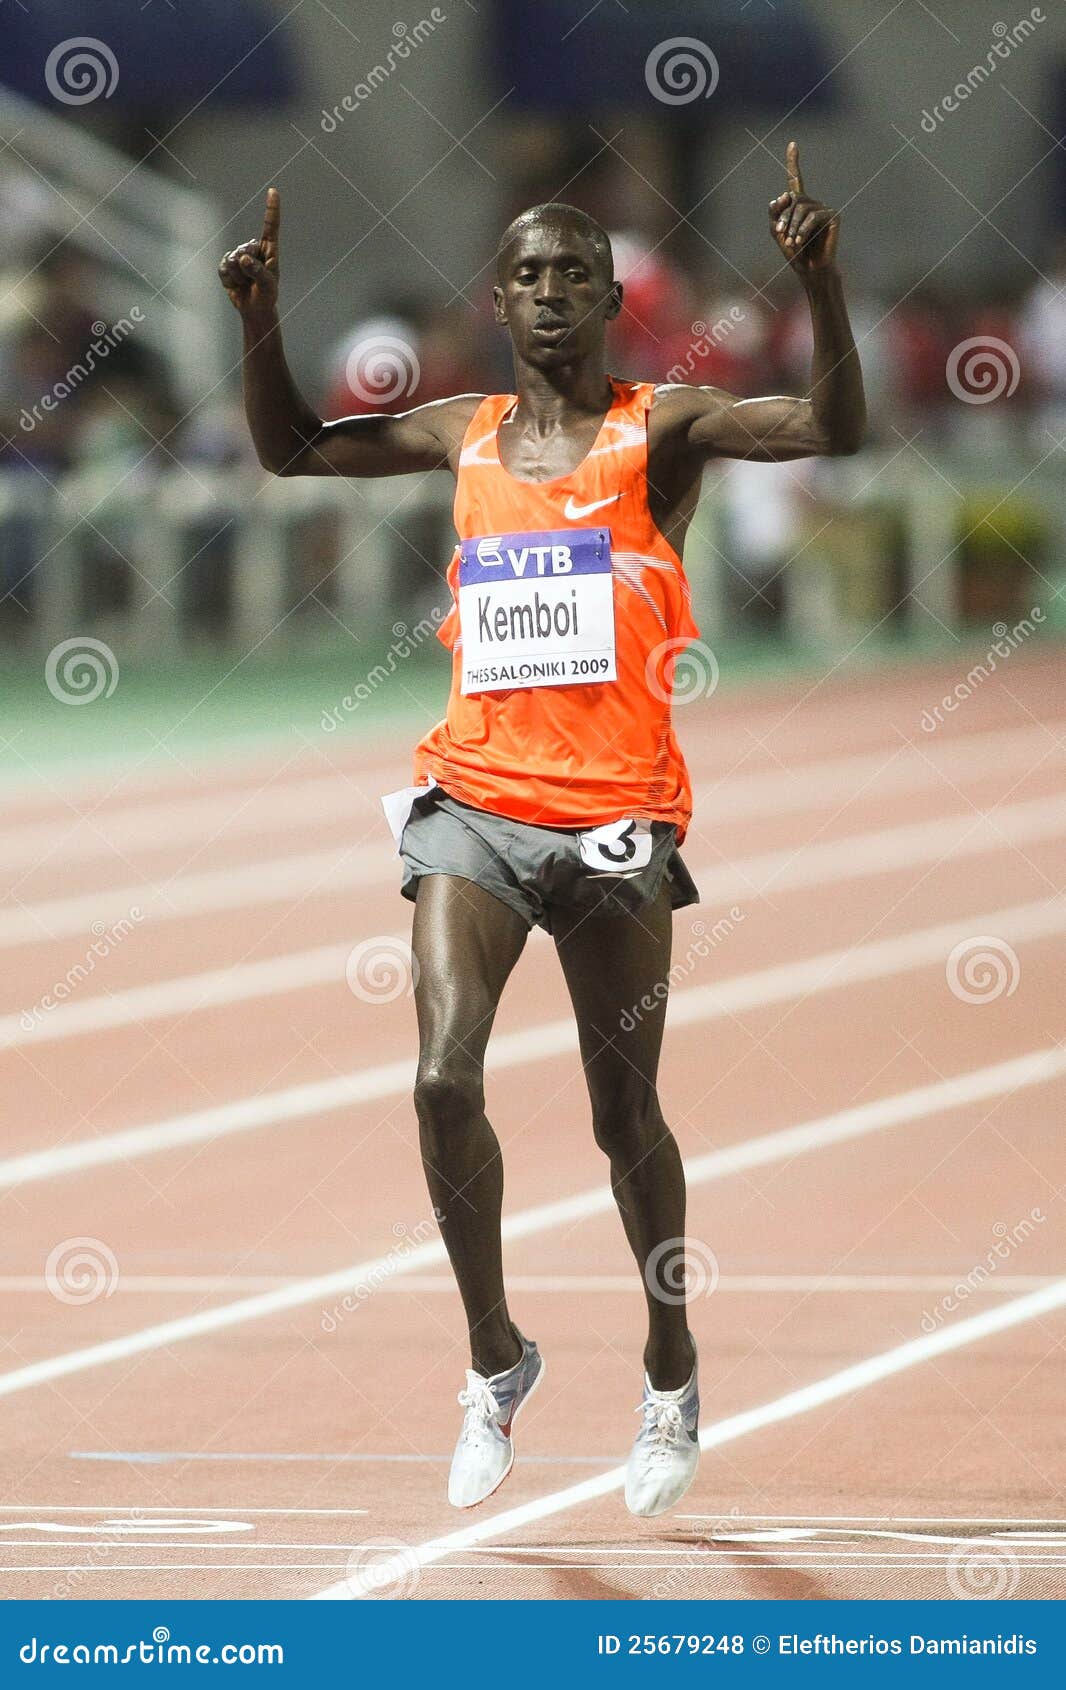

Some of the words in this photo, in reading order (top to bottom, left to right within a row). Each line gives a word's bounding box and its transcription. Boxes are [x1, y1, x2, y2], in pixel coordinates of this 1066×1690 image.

[507, 545, 573, 577] VTB
[478, 589, 578, 643] Kemboi
[467, 661, 566, 685] THESSALONIKI
[570, 658, 609, 675] 2009
[597, 819, 637, 863] 3
